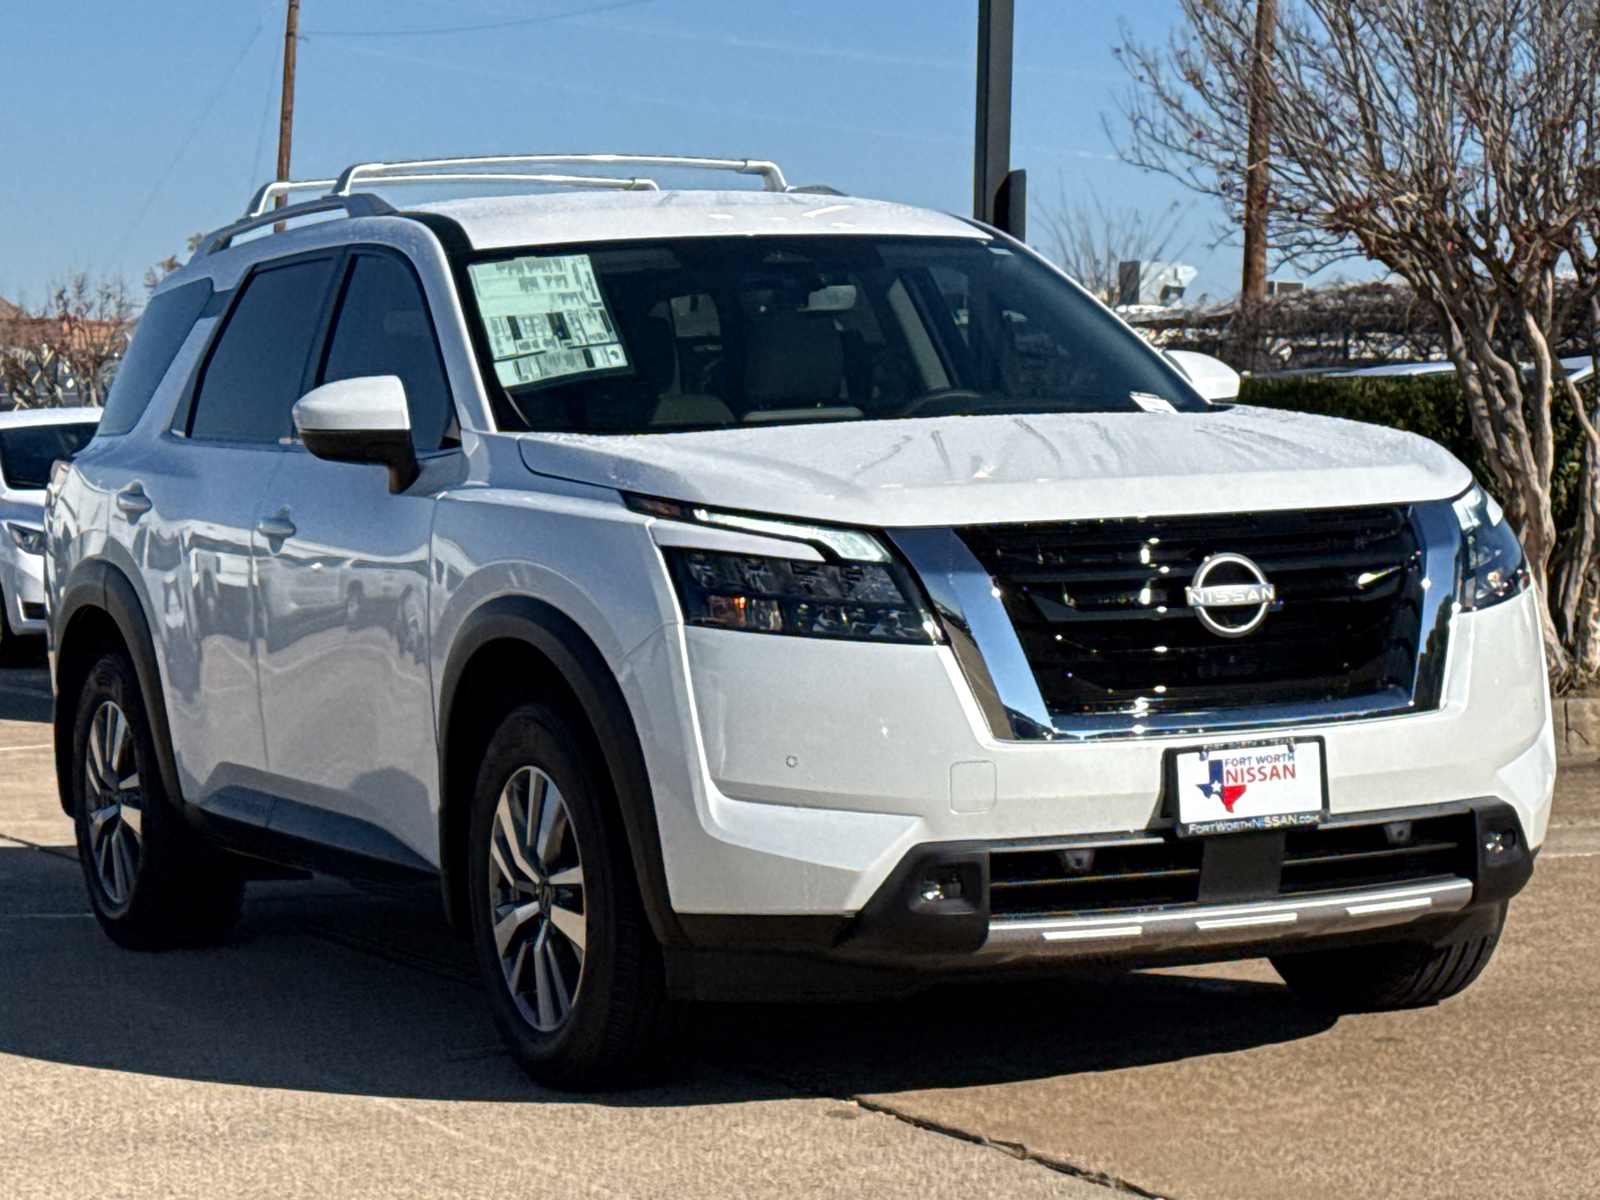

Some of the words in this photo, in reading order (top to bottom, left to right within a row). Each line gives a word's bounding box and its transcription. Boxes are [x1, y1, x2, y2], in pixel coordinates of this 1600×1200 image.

[1189, 587, 1275, 604] NISSAN
[1224, 756, 1253, 767] FORT
[1255, 752, 1295, 765] WORTH
[1226, 763, 1296, 784] NISSAN
